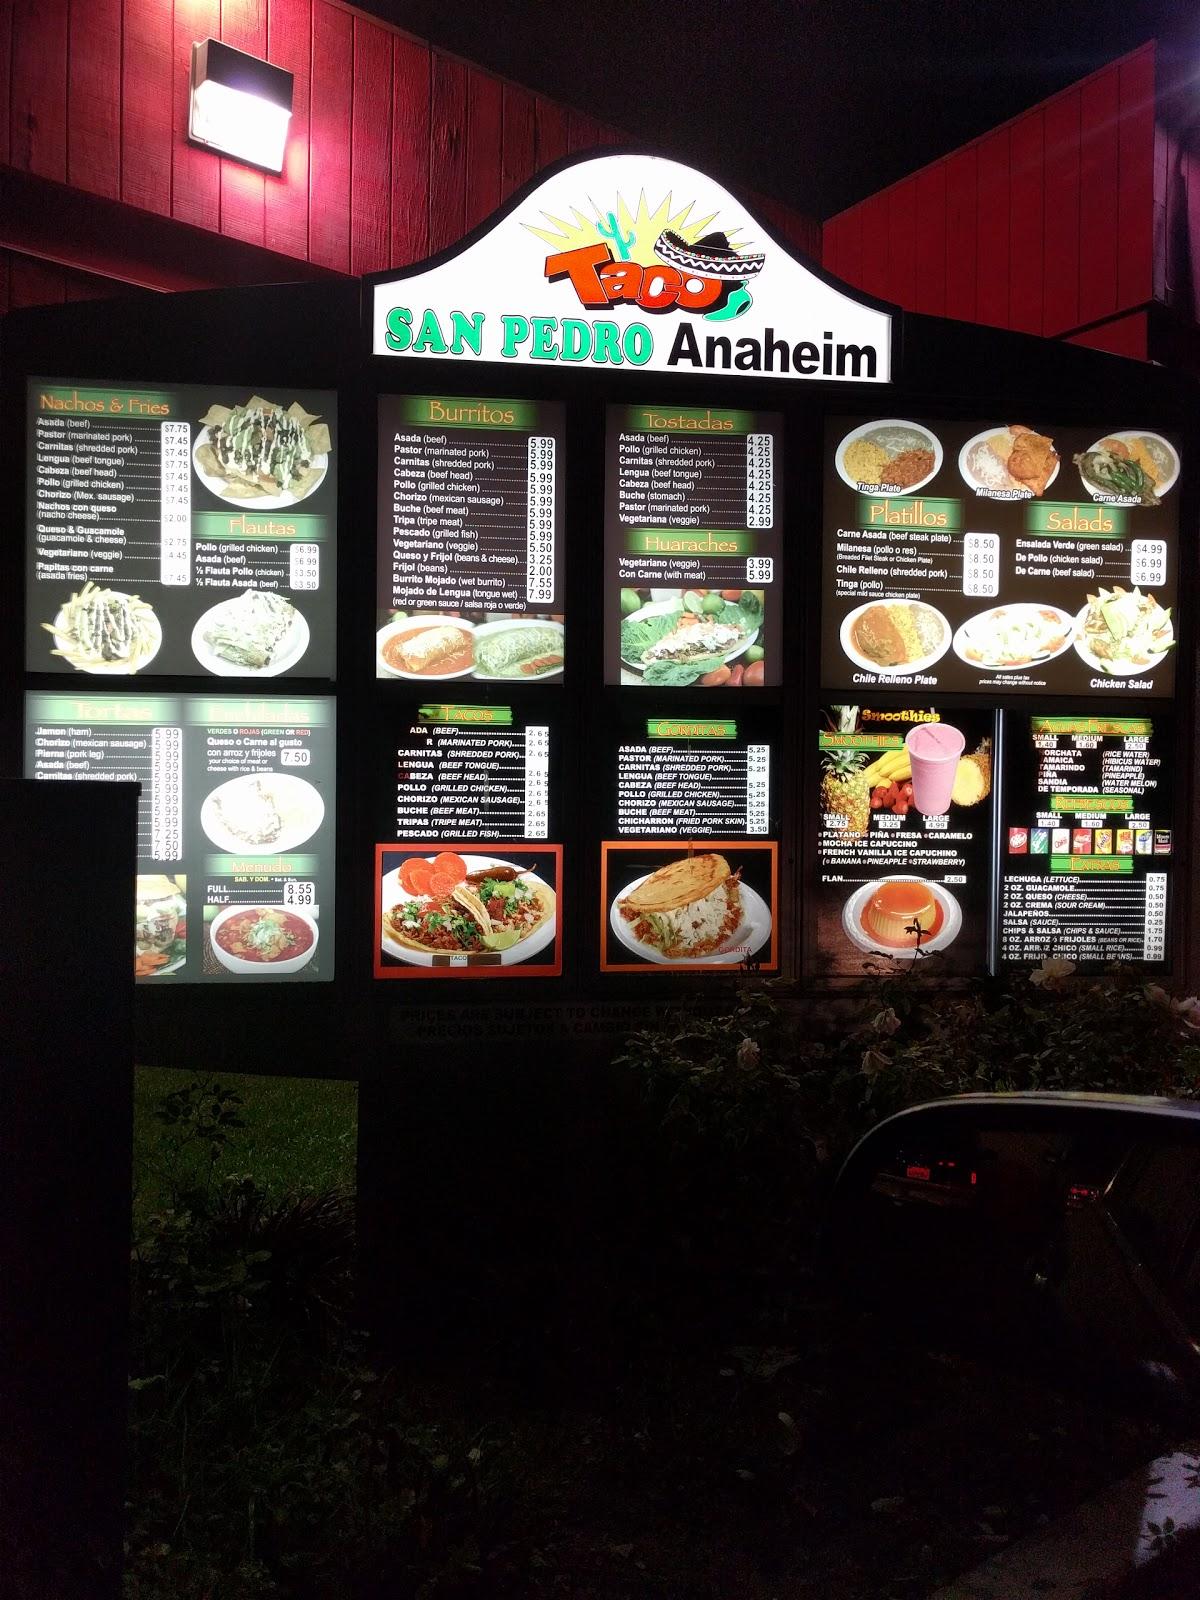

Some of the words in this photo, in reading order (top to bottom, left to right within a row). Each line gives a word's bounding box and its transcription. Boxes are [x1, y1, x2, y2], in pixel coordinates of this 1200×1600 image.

[544, 242, 724, 314] Taco
[384, 306, 486, 356] SAN
[500, 315, 653, 366] PEDRO
[667, 322, 877, 378] Anaheim
[40, 391, 104, 412] Nachos
[109, 399, 123, 412] &
[128, 399, 170, 416] Fries
[428, 401, 514, 424] Burritos
[37, 417, 65, 428] Asada
[67, 419, 90, 430] (beef)
[164, 424, 188, 433] $7.75
[643, 410, 734, 430] Tostadas
[37, 430, 65, 440] Pastor
[67, 431, 110, 441] (marinated
[112, 433, 133, 443] pork)
[394, 434, 421, 442] Asada
[423, 434, 447, 445] (beef)
[530, 438, 553, 449] 5.99
[619, 434, 645, 442] Asada
[646, 434, 669, 445] (beef)
[748, 436, 771, 446] 4.25
[37, 441, 73, 451] Carnitas
[75, 442, 115, 453] (shredded
[117, 445, 138, 455] pork)
[394, 445, 422, 454] Pastor
[424, 446, 466, 457] (marinated
[468, 449, 489, 458] pork)
[530, 450, 553, 459] 5.99
[619, 445, 640, 454] Pollo
[642, 446, 668, 456] (grilled
[670, 446, 701, 456] chicken)
[748, 447, 771, 457] 4.25
[394, 457, 430, 466] Carnitas
[432, 458, 471, 468] (shredded
[473, 461, 494, 470] pork)
[529, 461, 553, 470] 5.99
[619, 457, 653, 465] Carnitas
[655, 457, 694, 467] (shredded
[696, 459, 715, 468] pork)
[748, 458, 771, 468] 4.25
[37, 478, 60, 488] Pollo
[62, 479, 89, 490] (grilled
[92, 480, 124, 490] chicken)
[394, 480, 416, 489] Pollo
[418, 481, 445, 491] (grilled
[447, 482, 480, 493] chicken)
[529, 485, 553, 495] 5.99
[857, 483, 879, 494] Tinga
[881, 483, 901, 494] Plate
[37, 489, 72, 500] Chorizo
[74, 491, 96, 501] (Mex.
[98, 492, 134, 503] sausage)
[394, 492, 427, 501] Chorizo
[429, 493, 465, 503] (mexican
[467, 496, 503, 506] sausage)
[529, 497, 553, 506] 5.99
[976, 488, 1010, 498] Milanesa
[1012, 490, 1032, 500] Plate
[1093, 493, 1115, 503] Carne
[1117, 494, 1141, 504] Asada
[870, 501, 947, 526] Platillos
[230, 514, 296, 535] Flautas
[1047, 508, 1113, 532] Salads
[645, 532, 738, 552] Huaraches
[837, 529, 860, 539] Carne
[863, 530, 887, 540] Asada
[888, 531, 908, 542] (beef
[910, 532, 929, 541] steak
[931, 533, 952, 544] plate)
[968, 539, 995, 549] $8.50
[196, 543, 216, 552] Pollo
[219, 544, 244, 554] (grilled
[246, 544, 278, 554] chicken)
[1016, 539, 1050, 549] Ensalada
[1052, 540, 1075, 550] Verde
[1077, 542, 1100, 553] (green
[1102, 542, 1124, 553] salad)
[1136, 544, 1163, 555] $4.99
[196, 554, 221, 563] Asada
[224, 555, 246, 565] (beef)
[619, 558, 667, 568] Vegetariano
[669, 559, 700, 569] (veggie)
[748, 559, 771, 569] 3.99
[619, 570, 635, 578] Con
[637, 570, 662, 579] Carne
[664, 570, 682, 580] (with
[684, 571, 705, 581] meat)
[748, 570, 771, 580] 5.99
[853, 673, 877, 684] Chile
[879, 674, 912, 684] Relleno
[915, 675, 937, 685] Plate
[1090, 679, 1125, 689] Chicken
[1128, 679, 1153, 690] Salad
[861, 709, 940, 723] Smoothies
[35, 727, 66, 736] Jamon
[68, 727, 92, 738] (ham)
[154, 729, 179, 739] 5.99
[35, 738, 70, 747] Chorizo
[72, 738, 108, 748] (mexican
[110, 739, 146, 749] sausage)
[207, 737, 234, 747] Queso
[243, 738, 268, 746] Carne
[270, 738, 277, 746] al
[279, 738, 302, 747] gusto
[397, 750, 442, 758] CARNITAS
[447, 750, 494, 759] (SHREDDED
[496, 751, 520, 759] PORK)
[649, 746, 673, 754] (BEEF)
[284, 752, 307, 762] 7.50
[653, 755, 698, 763] (MARINATED
[701, 755, 725, 763] PORK)
[438, 762, 463, 770] (BEEF
[465, 762, 499, 770] TONGUE)
[619, 826, 677, 834] VEGETARIANO
[679, 826, 712, 834] (VEGGIE)
[870, 830, 889, 839] PIÑA
[896, 832, 922, 840] FRESA
[928, 832, 973, 840] CARAMELO
[232, 857, 292, 872] Menudo
[1043, 876, 1080, 884] (LETTUCE)
[207, 885, 228, 893] FULL
[287, 884, 312, 894] 8.55
[287, 895, 311, 905] 4.99
